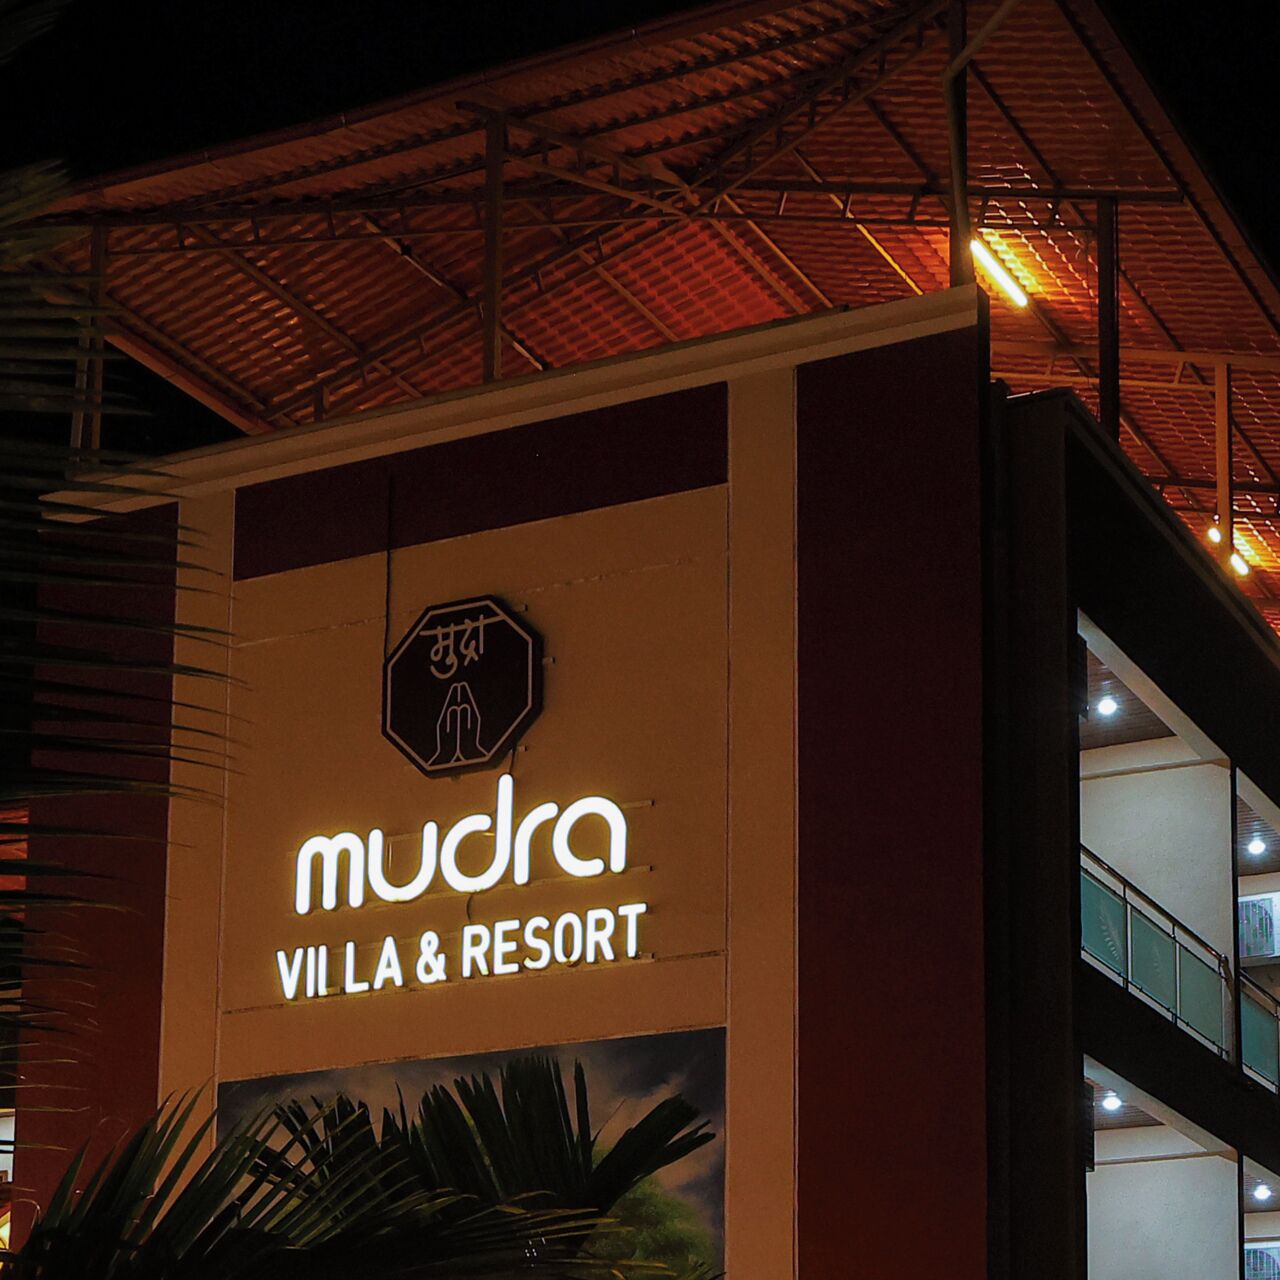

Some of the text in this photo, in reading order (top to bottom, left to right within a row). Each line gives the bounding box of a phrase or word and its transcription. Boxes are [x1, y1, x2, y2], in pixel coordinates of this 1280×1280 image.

[295, 774, 627, 915] mudra
[416, 931, 447, 985] &
[462, 903, 647, 978] RESORT
